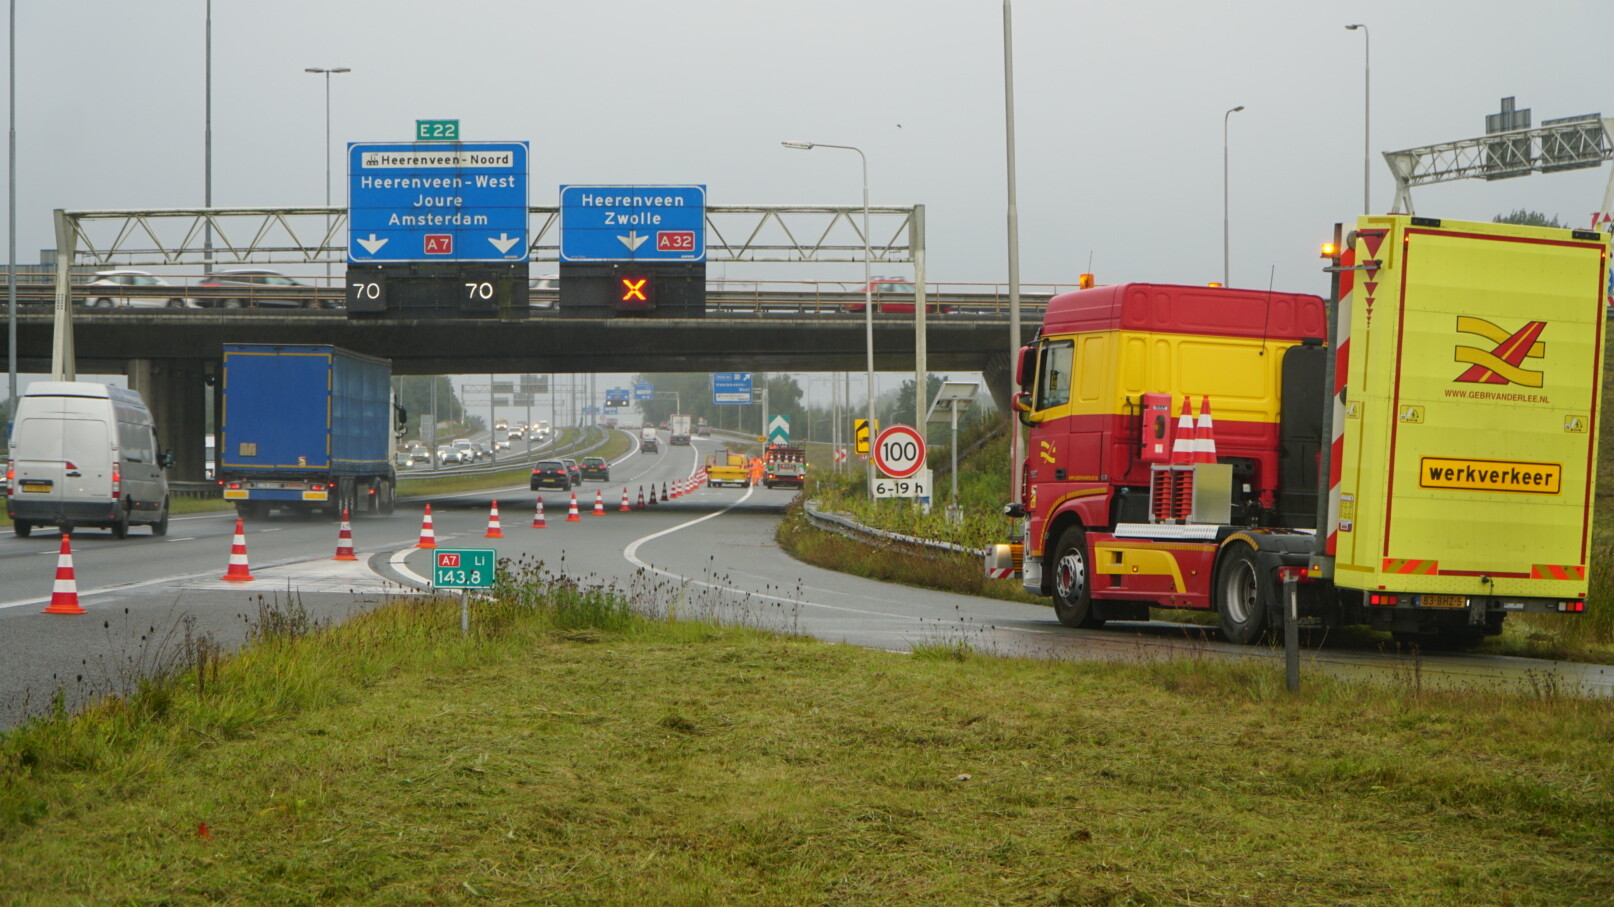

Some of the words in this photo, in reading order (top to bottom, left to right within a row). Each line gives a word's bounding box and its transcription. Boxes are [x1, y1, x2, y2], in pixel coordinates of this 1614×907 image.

[413, 194, 463, 207] Joure
[582, 193, 684, 207] Heerenveen
[388, 213, 488, 226] Amsterdam
[604, 211, 662, 225] Zwolle
[353, 282, 380, 300] 70
[465, 282, 494, 300] 70
[1444, 389, 1550, 404] WWW.GEBRVANDERLEE.NL
[883, 441, 917, 462] 100
[1429, 465, 1553, 486] werkverkeer
[876, 482, 910, 495] 6-19
[915, 482, 924, 494] h
[441, 555, 457, 566] A7
[474, 555, 485, 566] Li
